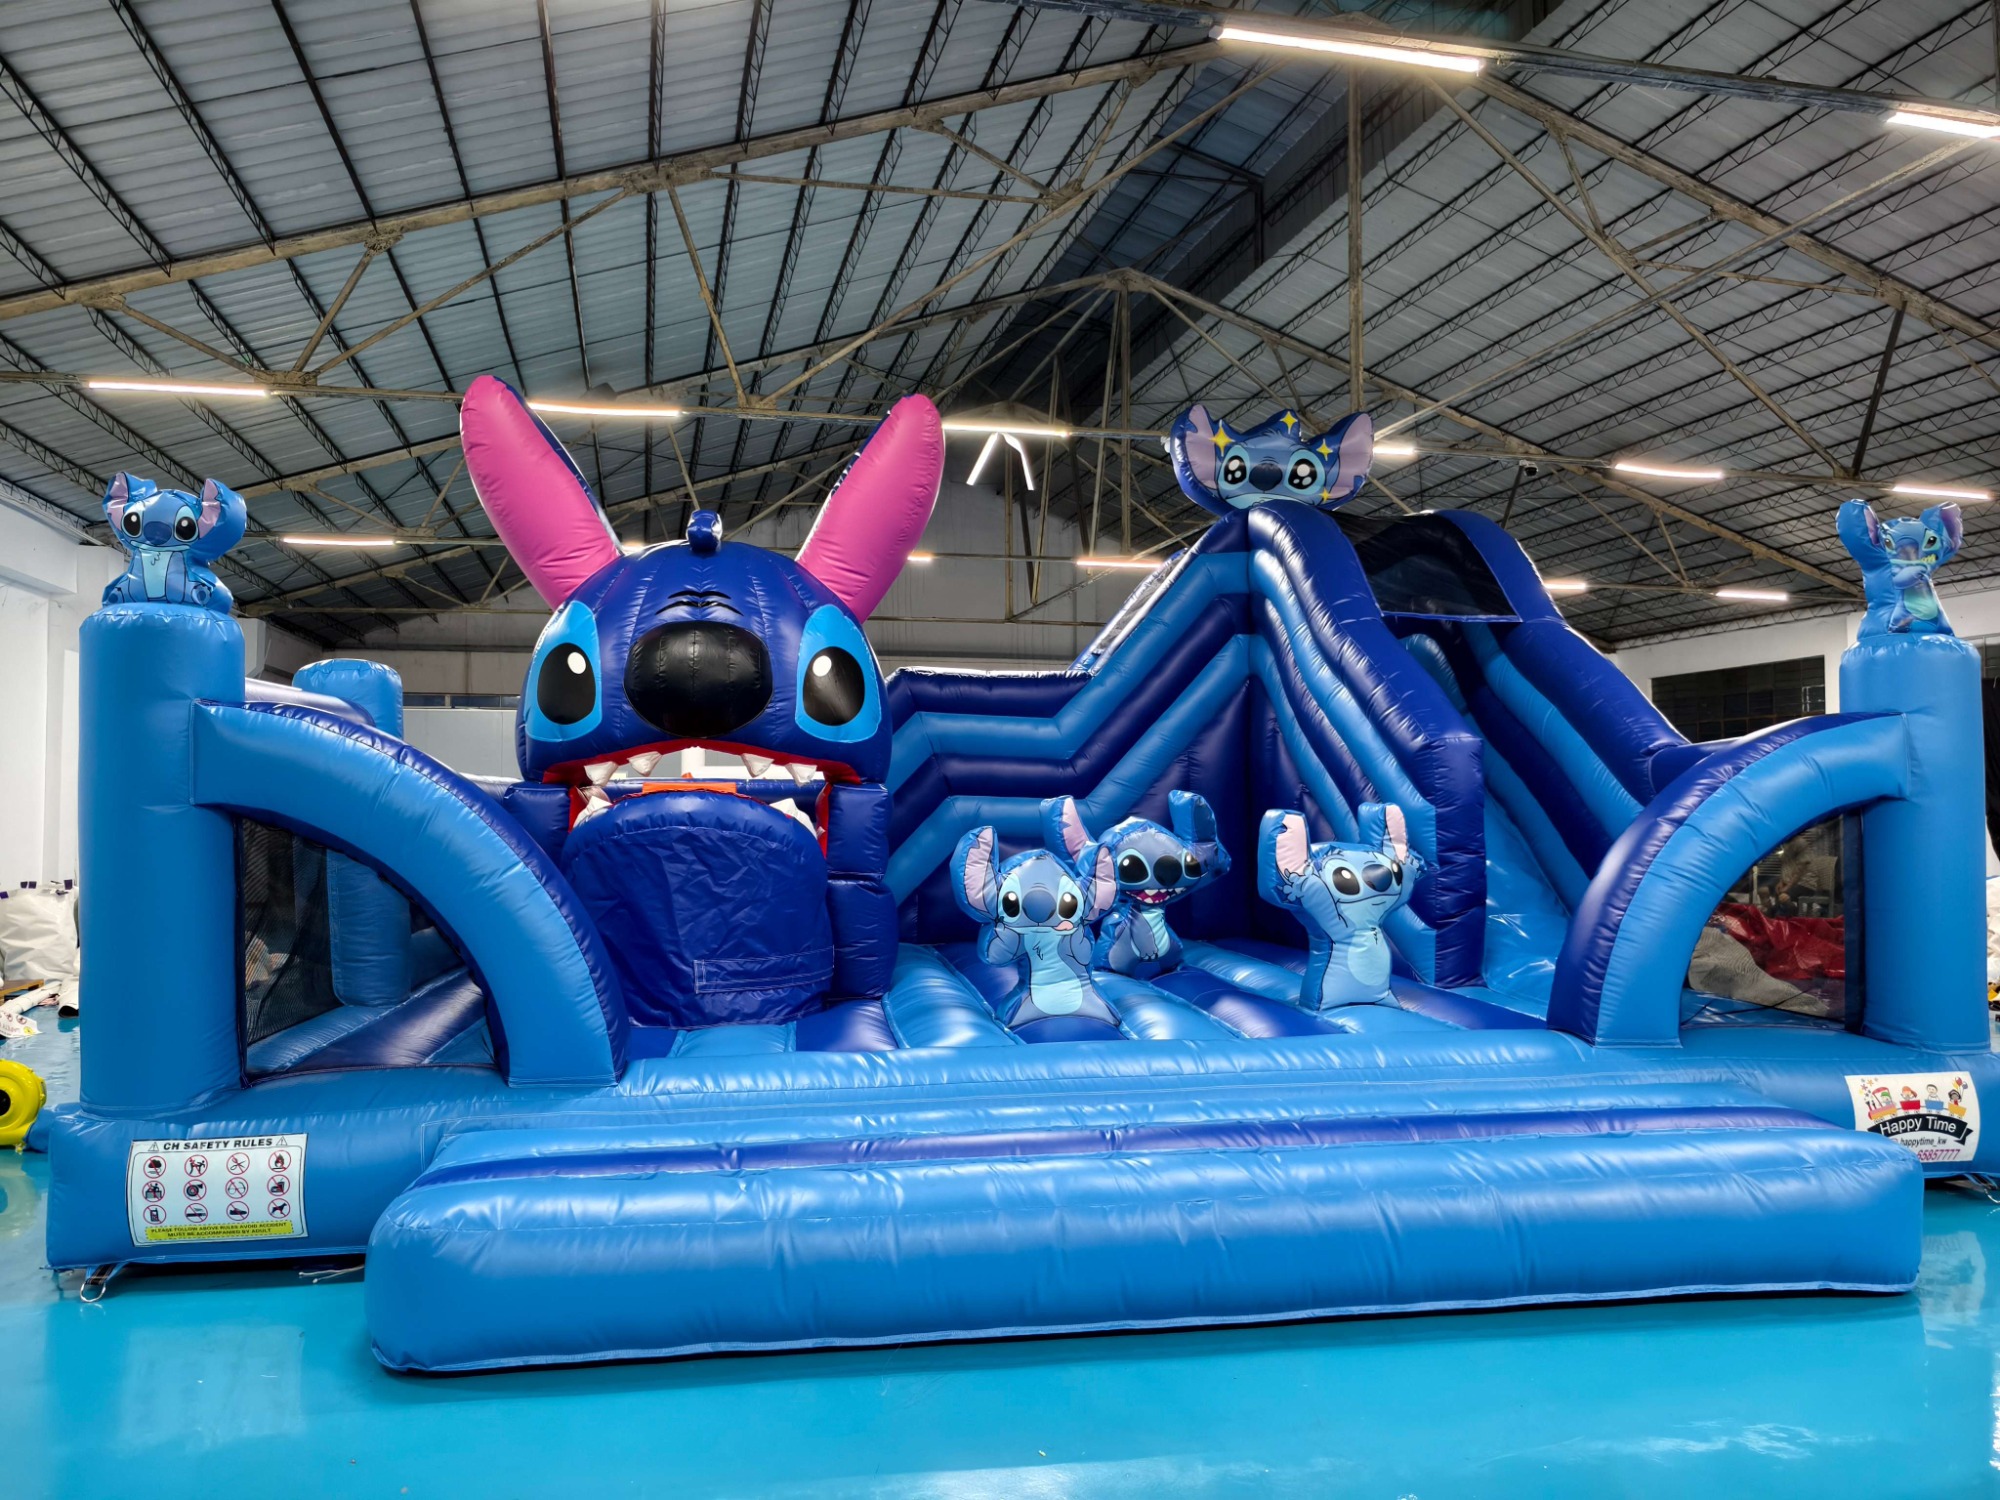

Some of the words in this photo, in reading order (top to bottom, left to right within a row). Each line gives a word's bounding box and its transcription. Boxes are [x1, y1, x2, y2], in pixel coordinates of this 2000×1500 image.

[1879, 1117, 1922, 1136] Happy
[1926, 1116, 1956, 1132] Time
[163, 1142, 180, 1151] CH
[184, 1140, 230, 1150] SAFETY
[234, 1138, 273, 1148] RULES
[1900, 1137, 1947, 1147] happytime_kw
